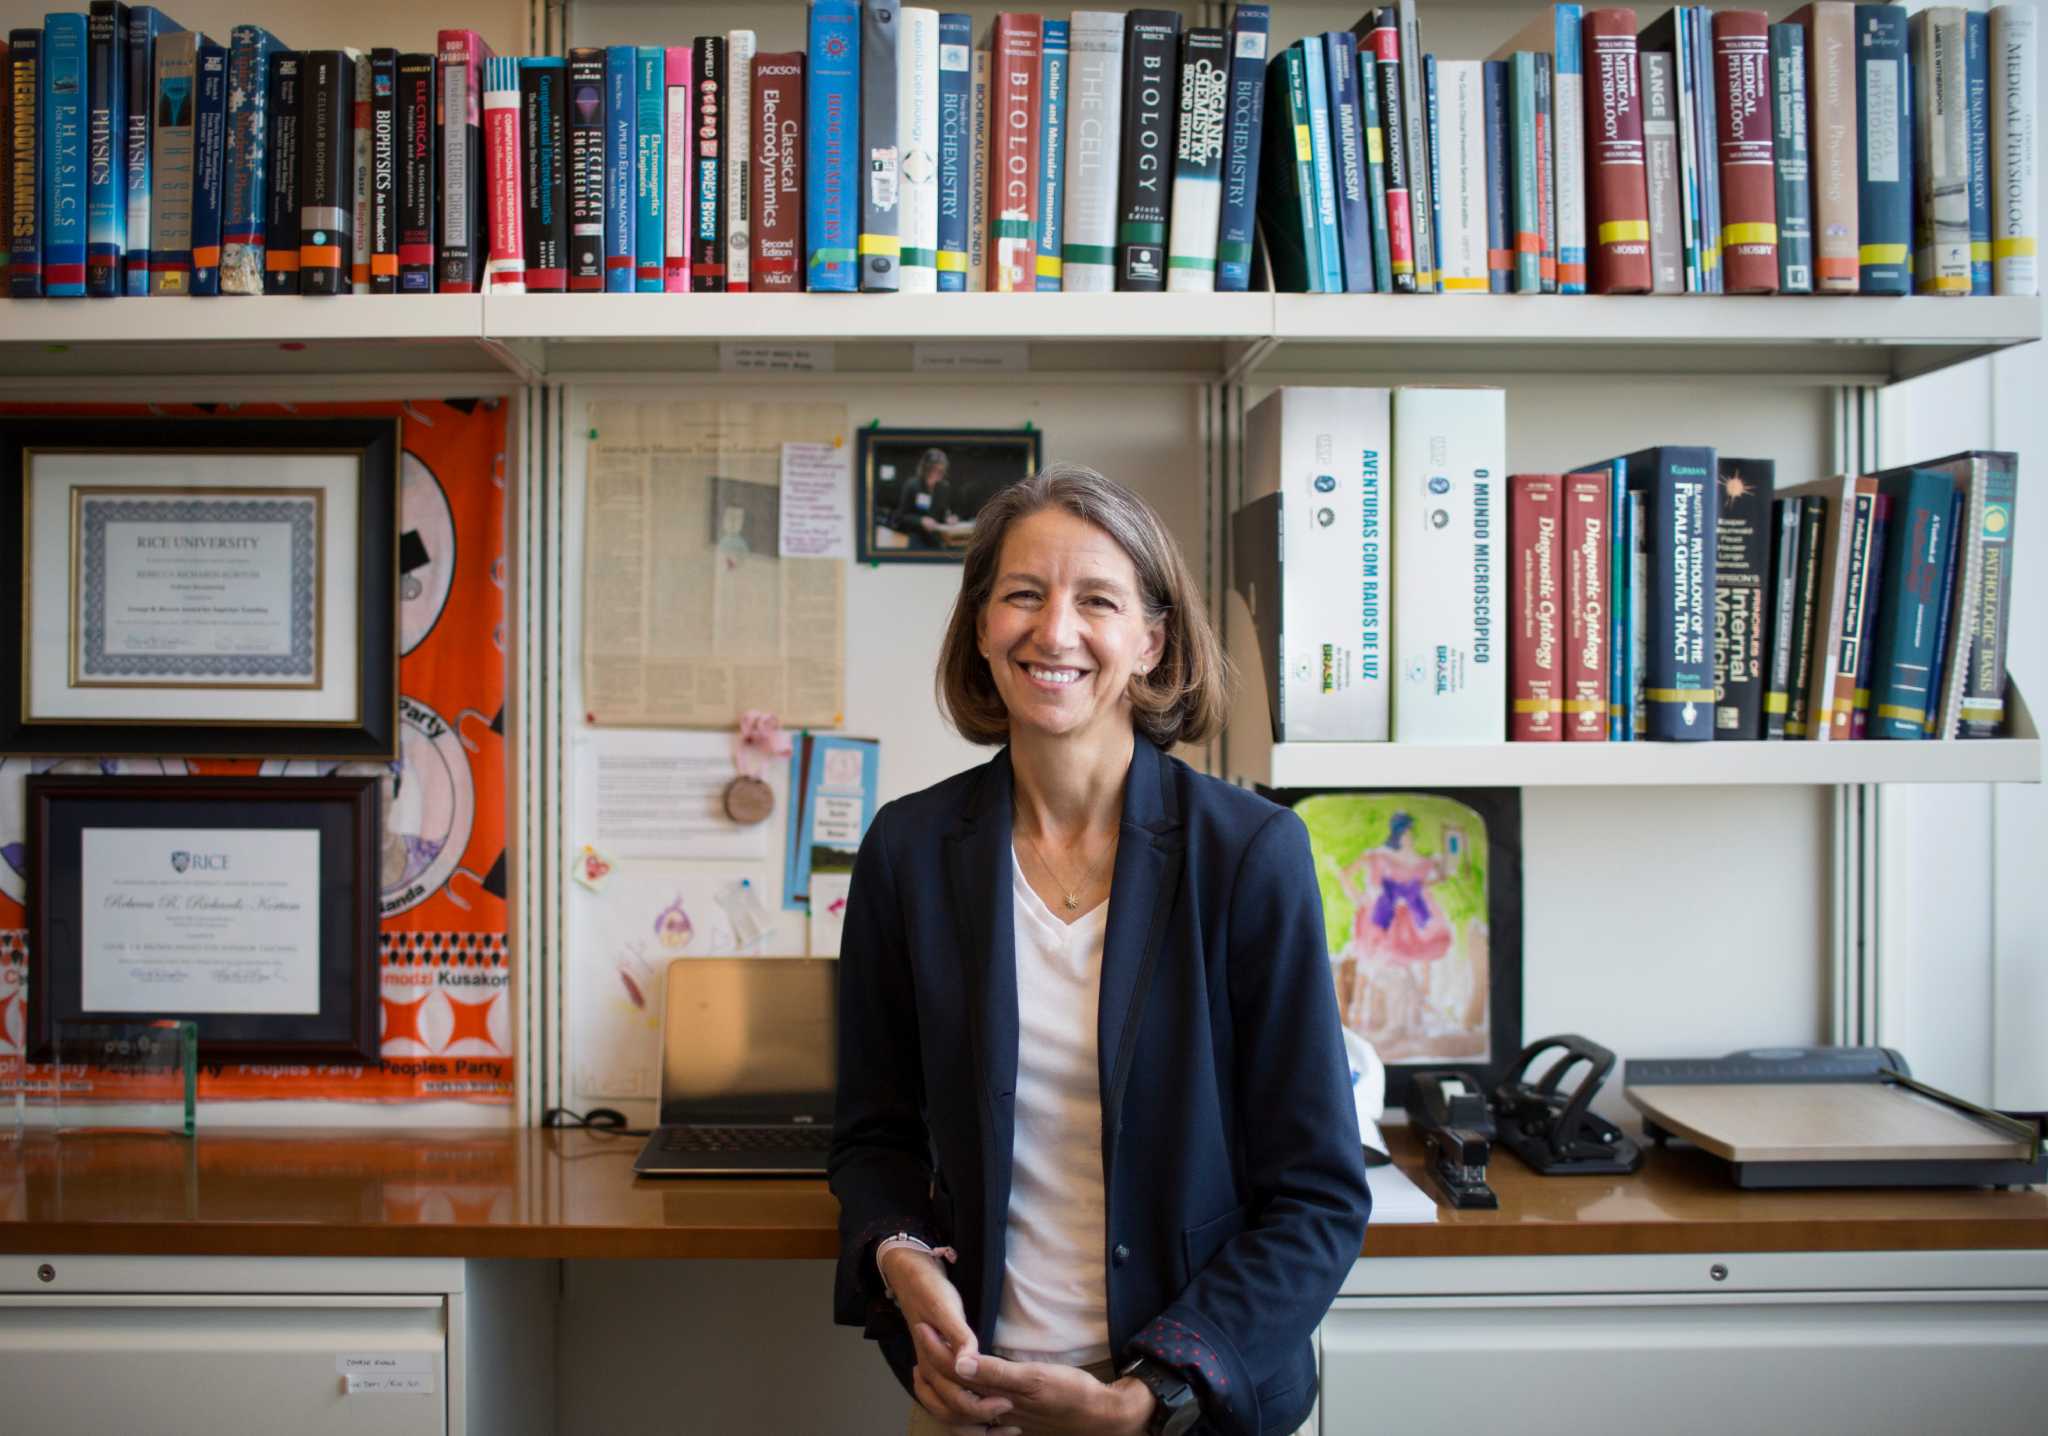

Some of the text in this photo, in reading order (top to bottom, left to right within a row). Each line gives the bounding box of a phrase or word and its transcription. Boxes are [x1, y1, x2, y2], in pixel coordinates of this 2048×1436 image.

[705, 39, 714, 77] MAXFIELD
[757, 65, 800, 77] JACKSON
[909, 20, 924, 143] essential cell biology
[1080, 61, 1103, 111] THE
[1602, 54, 1617, 139] PHYSIOLOGY
[1615, 54, 1630, 115] MEDICAL
[1649, 56, 1665, 117] LANGE
[1728, 54, 1744, 139] PHYSIOLOGY
[1742, 54, 1757, 117] MEDICAL
[1778, 57, 1793, 139] Surface Chemistry
[1792, 45, 1806, 151] Principles of Colloid and
[13, 59, 35, 237] THERMODYNAMICS
[92, 108, 111, 185] PHYSICS
[128, 114, 146, 190] PHYSICS
[315, 91, 327, 200] CELLULAR BIOPHYSICS
[406, 105, 414, 142] Principles
[416, 80, 426, 226] ELECTRICAL ENGINEERING
[539, 75, 553, 225] Computational Electrodynamics
[759, 89, 780, 228] Electrodynamics
[781, 120, 797, 193] Classical
[942, 93, 957, 219] BIOCHEMISTRY
[975, 83, 984, 149] BIOCHEMICAL
[1007, 71, 1028, 220] BIOLOGY
[1043, 60, 1060, 250] Cellular and Molecular Immunology
[1080, 119, 1103, 176] CELL
[1138, 56, 1160, 193] BIOLOGY
[1178, 63, 1192, 160] SECOND EDITION
[1189, 58, 1211, 166] CHEMISTRY
[1207, 69, 1226, 159] ORGANIC
[1228, 81, 1251, 207] BIOCHEMISTRY
[1339, 103, 1359, 201] IMMUNOASSAY
[1385, 67, 1402, 185] INTEGRATED COLPOSCOPY
[1827, 37, 1846, 203] Anatomy Physiology
[1869, 69, 1882, 174] PHYSIOLOGY
[1882, 84, 1895, 158] MEDICAL
[1971, 79, 1986, 211] HUMAN PHYSIOLOGY
[2006, 43, 2024, 236] MEDICAL PHYSIOLOG
[62, 105, 77, 226] PHYSICS
[160, 130, 191, 236] PHYSICS
[376, 110, 391, 252] BIOPHYSICS An Introduction
[406, 160, 414, 207] Applications
[449, 142, 463, 189] ELECTRIC
[504, 113, 516, 253] COMPUTATIONAL ELECTRODYNAMICS
[573, 131, 587, 217] ENGINEERING
[589, 131, 602, 217] ELECTRICAL
[618, 120, 629, 255] APPLIED ELECTROMAGNETISM
[638, 134, 648, 197] for Engineers
[650, 134, 660, 216] Electromagnetics
[825, 95, 841, 241] BIOCHEMISTRY
[1314, 108, 1334, 225] Immunoassays
[1652, 140, 1664, 234] Medical Physiology
[357, 202, 367, 251] Biophysics
[449, 193, 463, 240] CIRCUITS
[136, 535, 260, 550] RICE UNIVERSITY
[1361, 449, 1380, 680] AVENTURAS COM RAIOS DE LUZ
[1472, 468, 1492, 664] O MUNDO MICROSCÓPICO
[1673, 483, 1692, 664] FEMALE GENITAL TRACT
[1534, 517, 1555, 669] Diagnostic Cytology
[1581, 518, 1602, 670] Diagnostic Cytology
[1690, 537, 1704, 664] PATHOLOGY OF THE
[1730, 588, 1749, 683] Internal
[1750, 589, 1761, 677] PRINCIPLES OF
[1980, 547, 2000, 691] PATHOLOGIC BASIS
[1320, 643, 1334, 694] BRASIL
[1434, 645, 1448, 696] BRASIL
[1714, 588, 1730, 702] Medicine
[191, 853, 231, 871] RICE
[455, 1057, 502, 1077] Party
